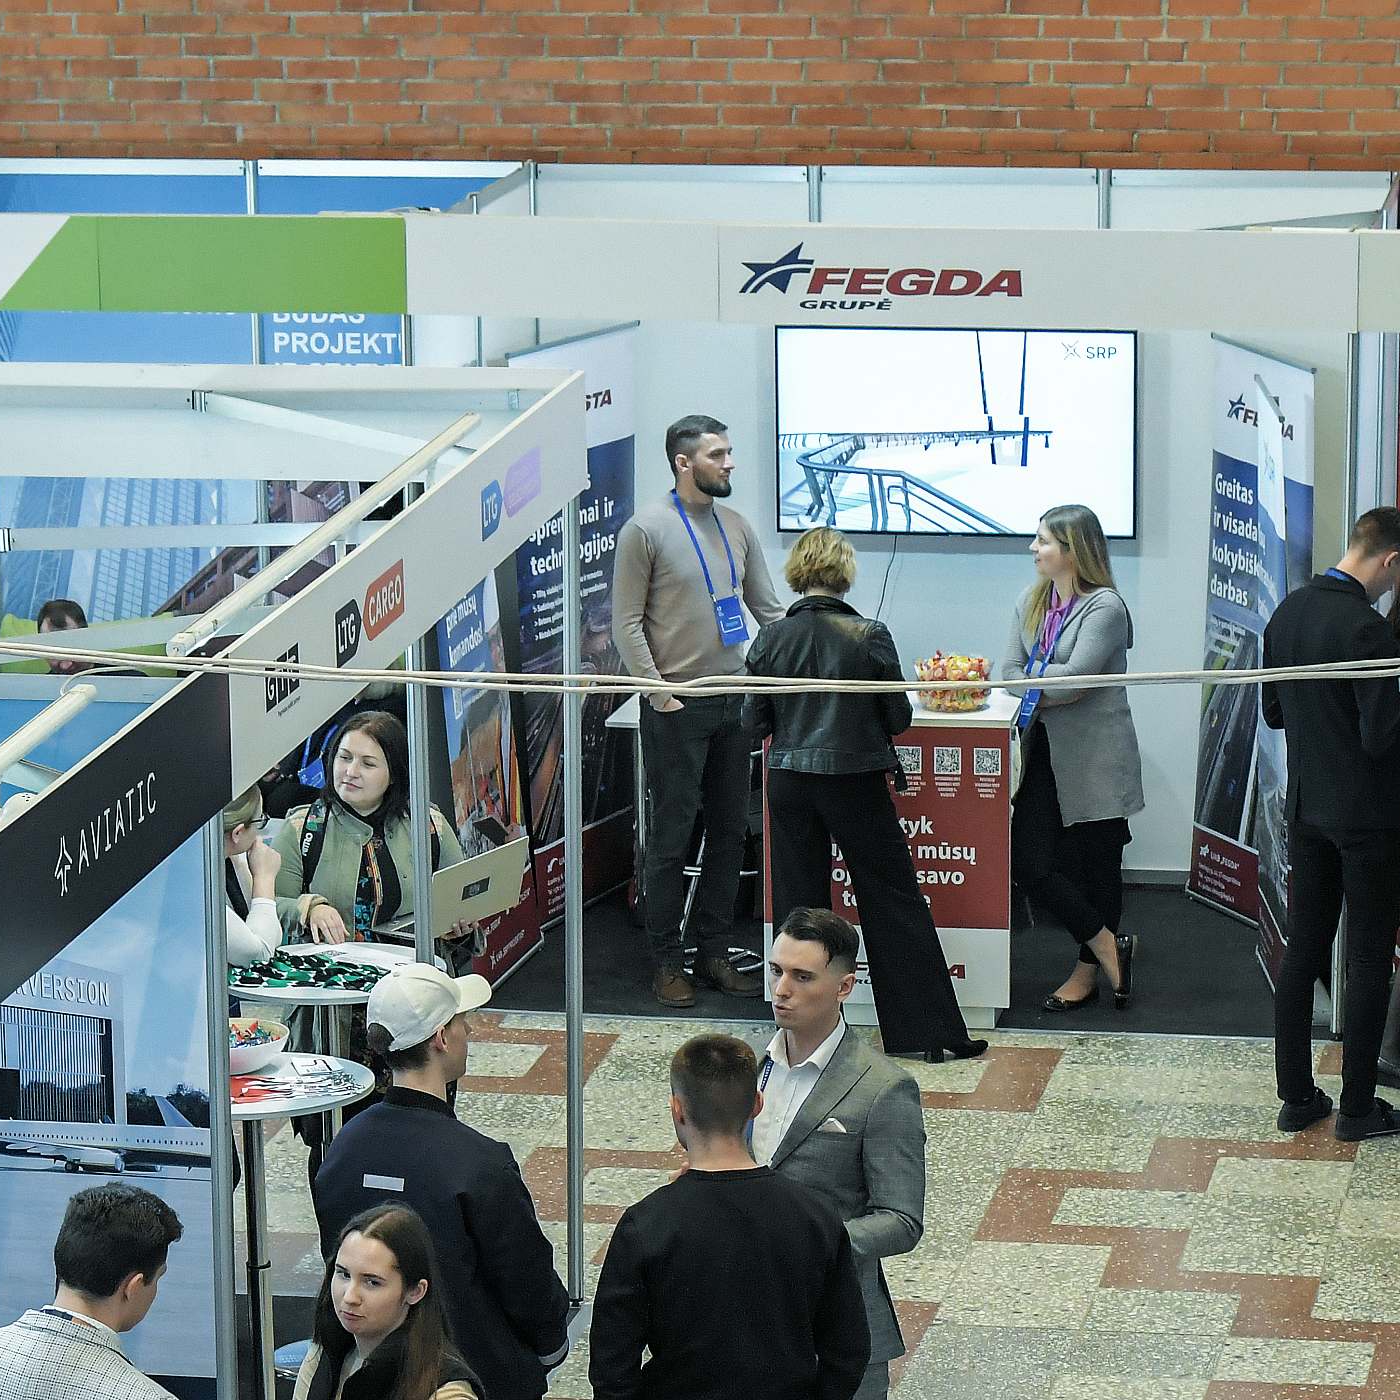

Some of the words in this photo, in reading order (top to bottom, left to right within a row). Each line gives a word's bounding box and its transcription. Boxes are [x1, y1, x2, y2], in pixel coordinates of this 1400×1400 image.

[806, 267, 1023, 297] FEGDA
[799, 298, 893, 311] GRUPĖ
[274, 332, 401, 354] PROJEKT
[1086, 346, 1117, 360] SRP
[1215, 472, 1254, 506] Greitas
[482, 493, 498, 528] LTG
[603, 496, 615, 519] ir
[1212, 506, 1222, 529] ir
[1222, 514, 1258, 543] visada
[1210, 575, 1249, 607] darbas
[337, 612, 357, 654] LTG
[367, 574, 403, 627] CARGO
[78, 771, 158, 875] AVIATIC
[917, 841, 977, 865] mūsų
[916, 870, 965, 885] savo
